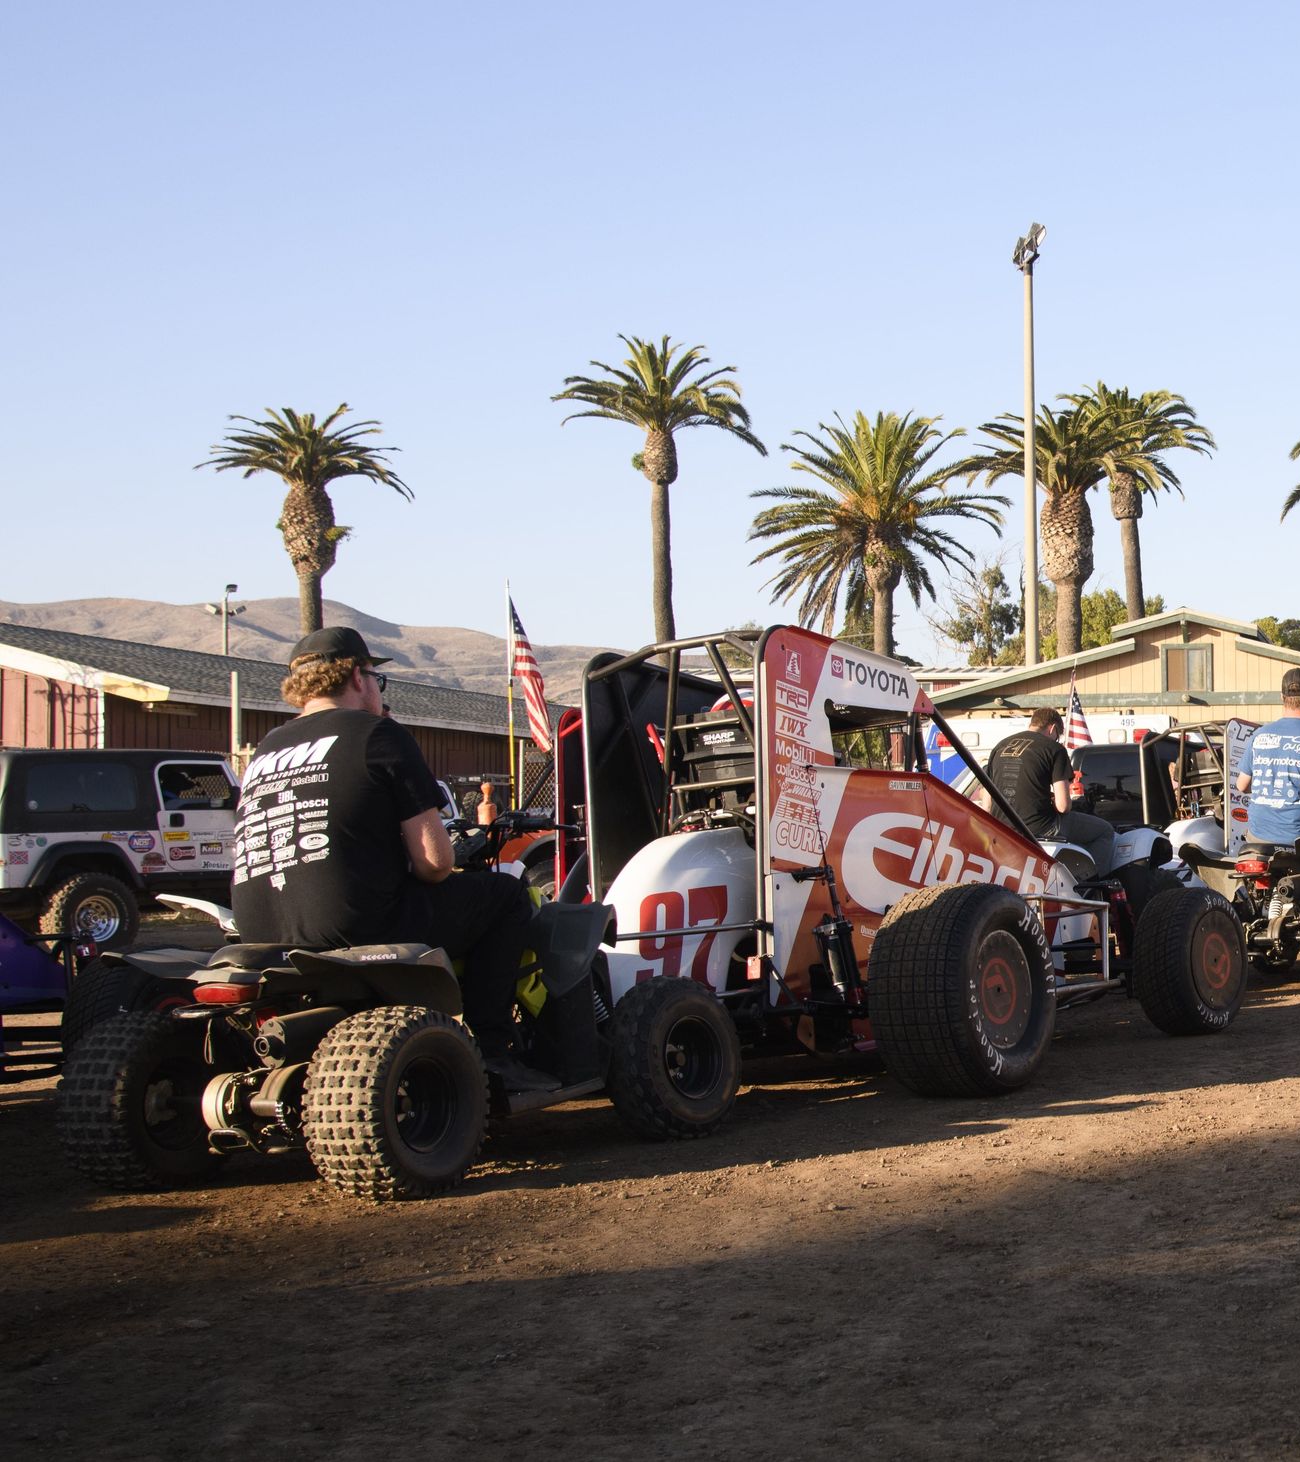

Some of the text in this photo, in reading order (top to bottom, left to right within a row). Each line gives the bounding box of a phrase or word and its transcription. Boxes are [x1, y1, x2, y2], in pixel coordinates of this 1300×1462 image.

[845, 658, 909, 699] TOYOTA
[777, 686, 808, 708] TRD
[779, 715, 808, 738] IWX
[1121, 719, 1135, 727] 495
[702, 731, 735, 741] SHARP
[775, 739, 807, 762] Mobil
[265, 764, 329, 781] MOTORSPORTS
[295, 798, 328, 810] BOSCH
[776, 820, 828, 855] CURB
[202, 861, 229, 869] Hoosier
[841, 812, 1045, 916] Eibach
[635, 885, 728, 993] 97
[1018, 905, 1056, 997] Hoosier
[968, 980, 1005, 1075] Hoosier
